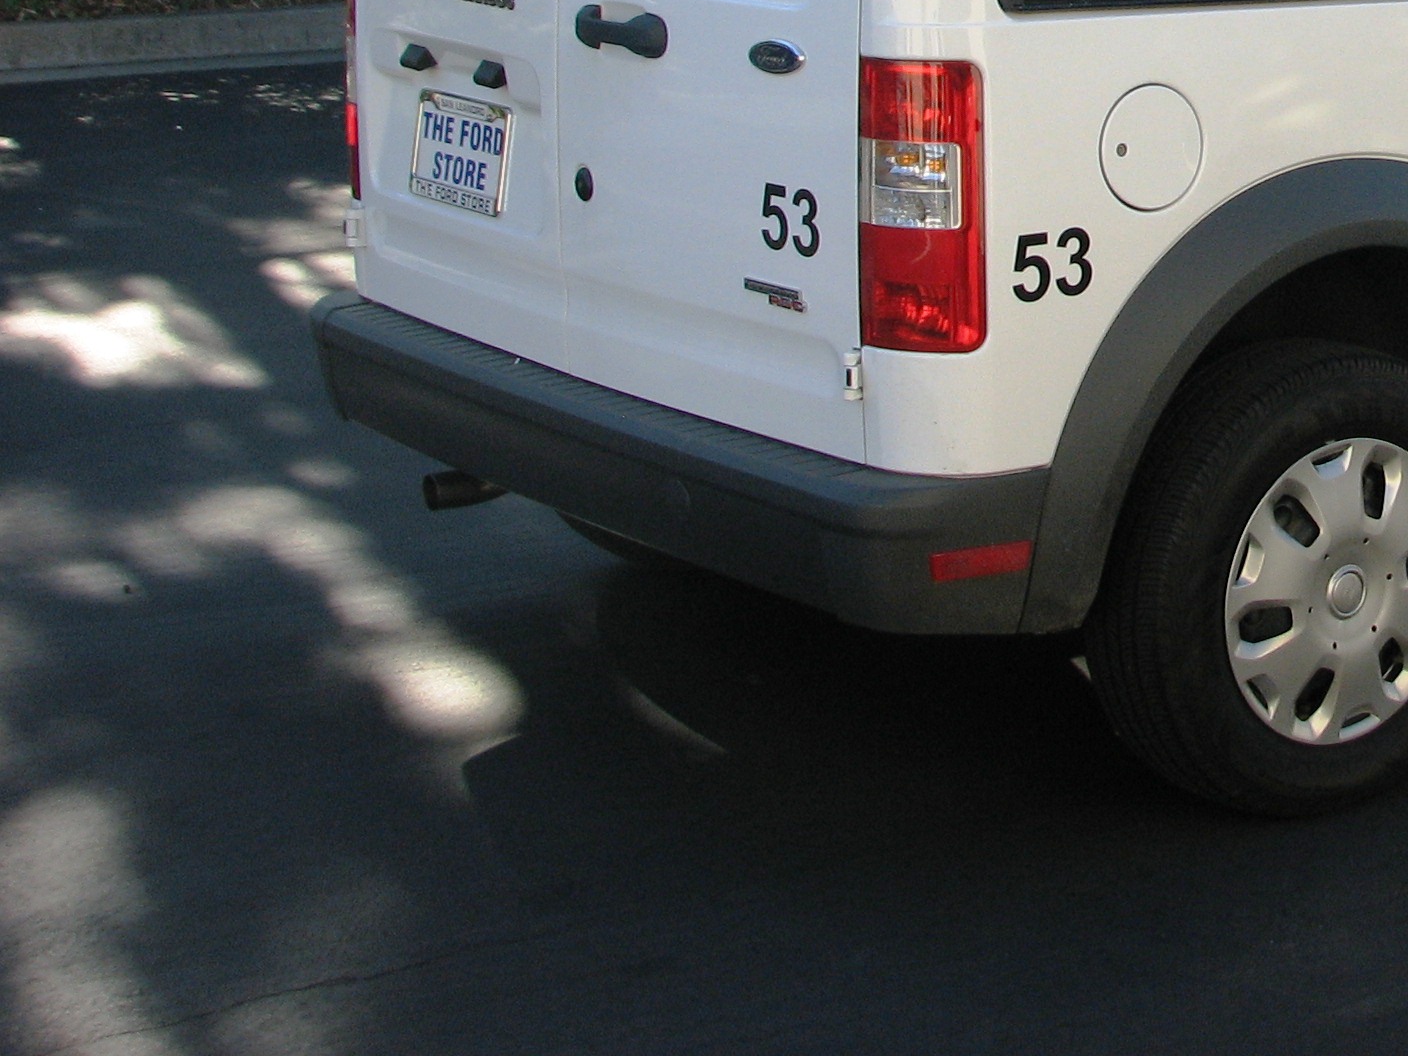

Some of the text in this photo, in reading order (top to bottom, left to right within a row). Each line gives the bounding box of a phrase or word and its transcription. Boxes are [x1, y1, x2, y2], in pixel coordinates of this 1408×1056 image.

[423, 111, 504, 156] THE FORD
[432, 151, 488, 191] STORE
[415, 180, 493, 214] THE FORD STORE
[761, 181, 821, 258] 53
[1012, 227, 1094, 303] 53
